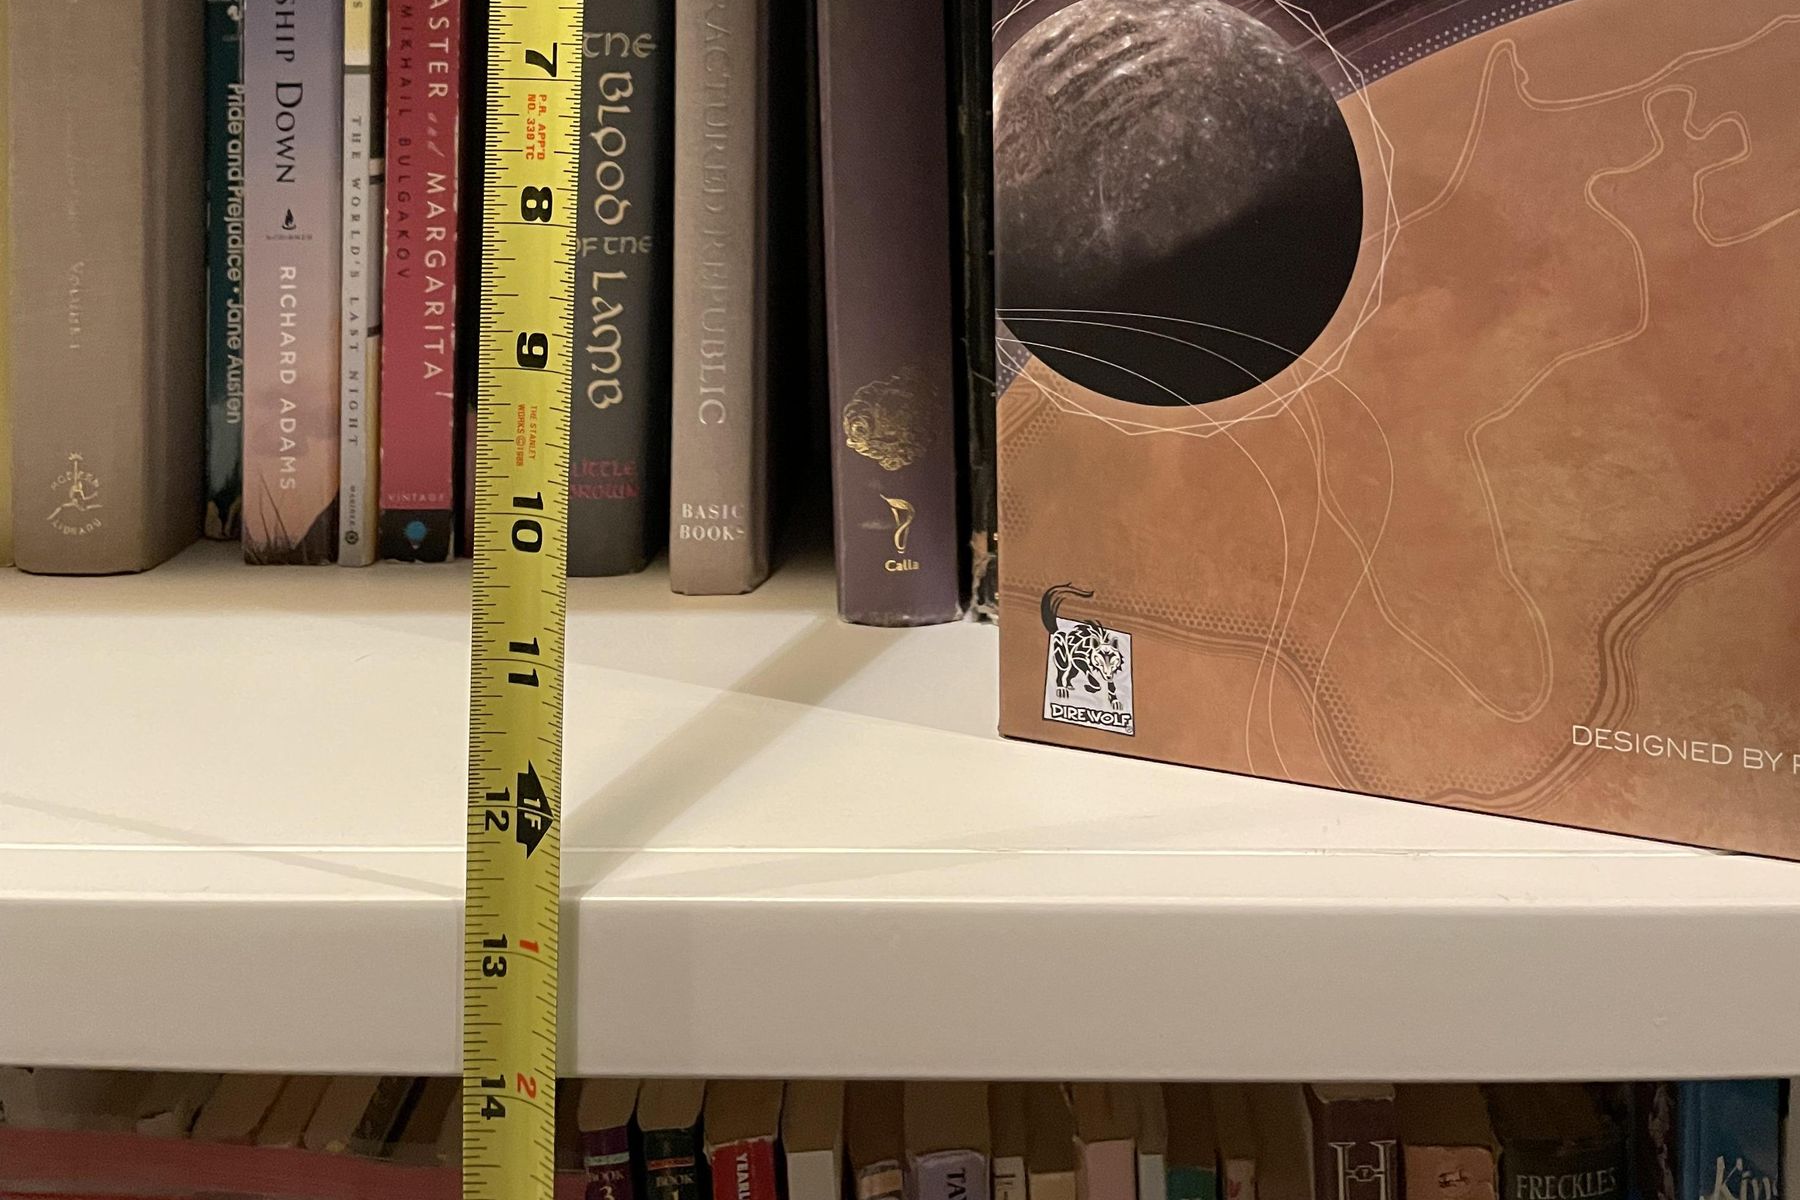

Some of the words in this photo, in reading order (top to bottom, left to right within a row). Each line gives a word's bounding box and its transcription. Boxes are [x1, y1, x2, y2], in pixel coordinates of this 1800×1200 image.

[399, 5, 412, 116] MIKHAIL
[525, 42, 557, 78] 7
[227, 140, 245, 181] and
[351, 116, 362, 159] THE
[396, 137, 412, 279] BULGAKOV
[520, 185, 553, 222] 8
[223, 185, 245, 282] Prejudice
[424, 172, 447, 379] MARGARITA
[226, 299, 244, 350] Jane
[280, 266, 297, 385] RICHARD
[348, 297, 360, 352] LAST
[699, 230, 727, 425] REPUBLIC
[517, 332, 549, 369] 9
[226, 354, 244, 424] Austen
[348, 370, 360, 446] NIGHT
[280, 398, 297, 490] ADAMS
[511, 491, 544, 553] 10
[681, 503, 744, 519] BASIC
[884, 558, 921, 572] Calla
[508, 637, 540, 687] 11
[1572, 725, 1733, 766] DESIGNED
[1743, 748, 1783, 772] BY
[484, 787, 511, 832] 12
[482, 934, 508, 978] 13
[481, 1074, 506, 1121] 14
[517, 1072, 537, 1099] 2
